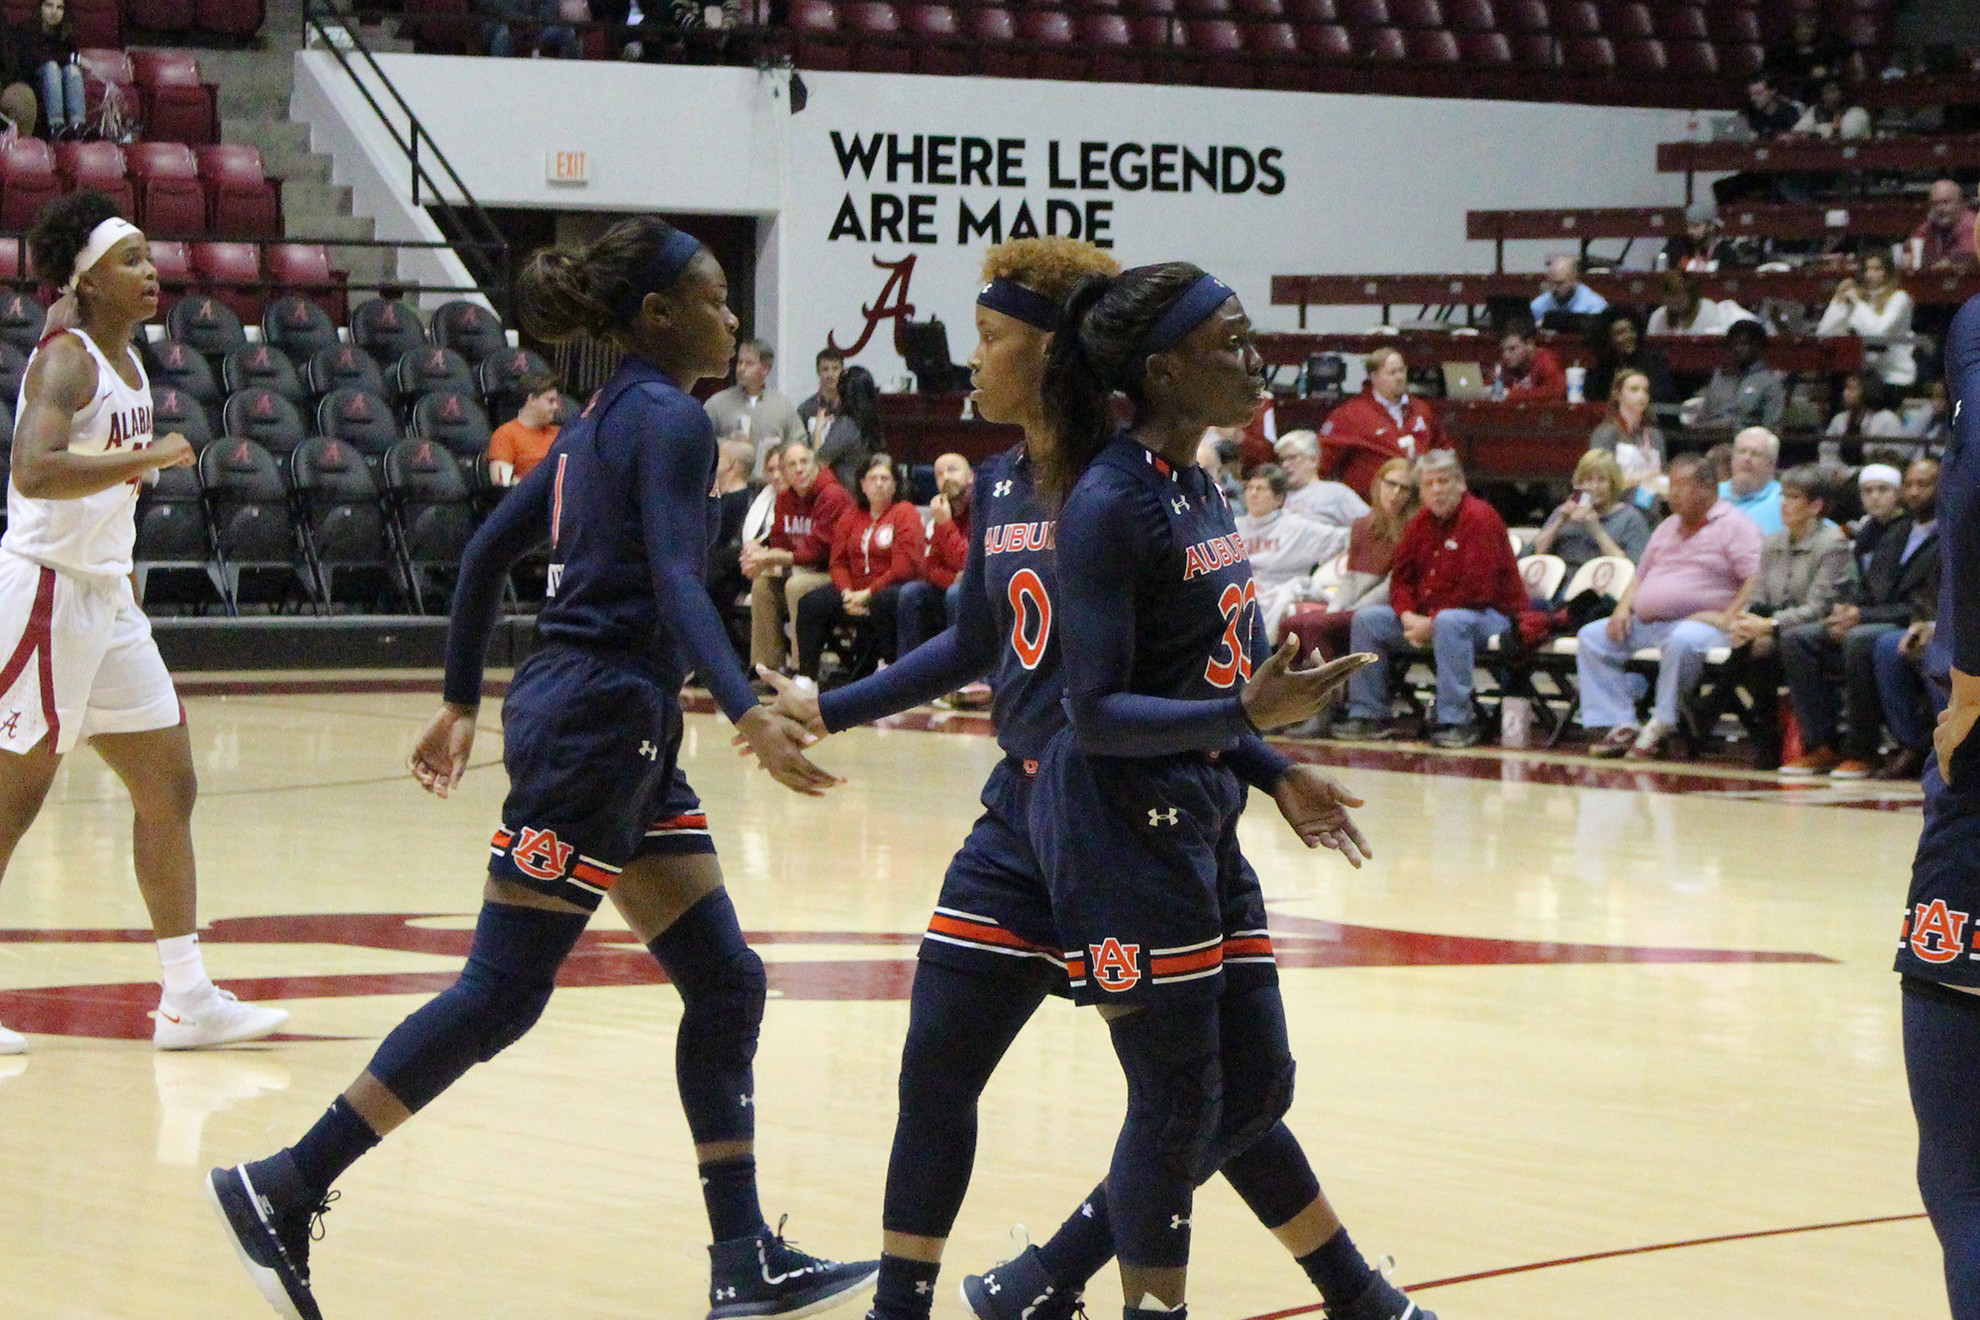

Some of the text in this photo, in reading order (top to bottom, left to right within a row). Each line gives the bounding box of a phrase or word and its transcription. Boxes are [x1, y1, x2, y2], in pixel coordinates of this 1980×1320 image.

[557, 151, 585, 178] EXIT
[829, 130, 1286, 196] WHERE LEGENDS
[827, 192, 1114, 249] ARE MADE
[828, 253, 917, 358] A
[1008, 568, 1052, 670] 0
